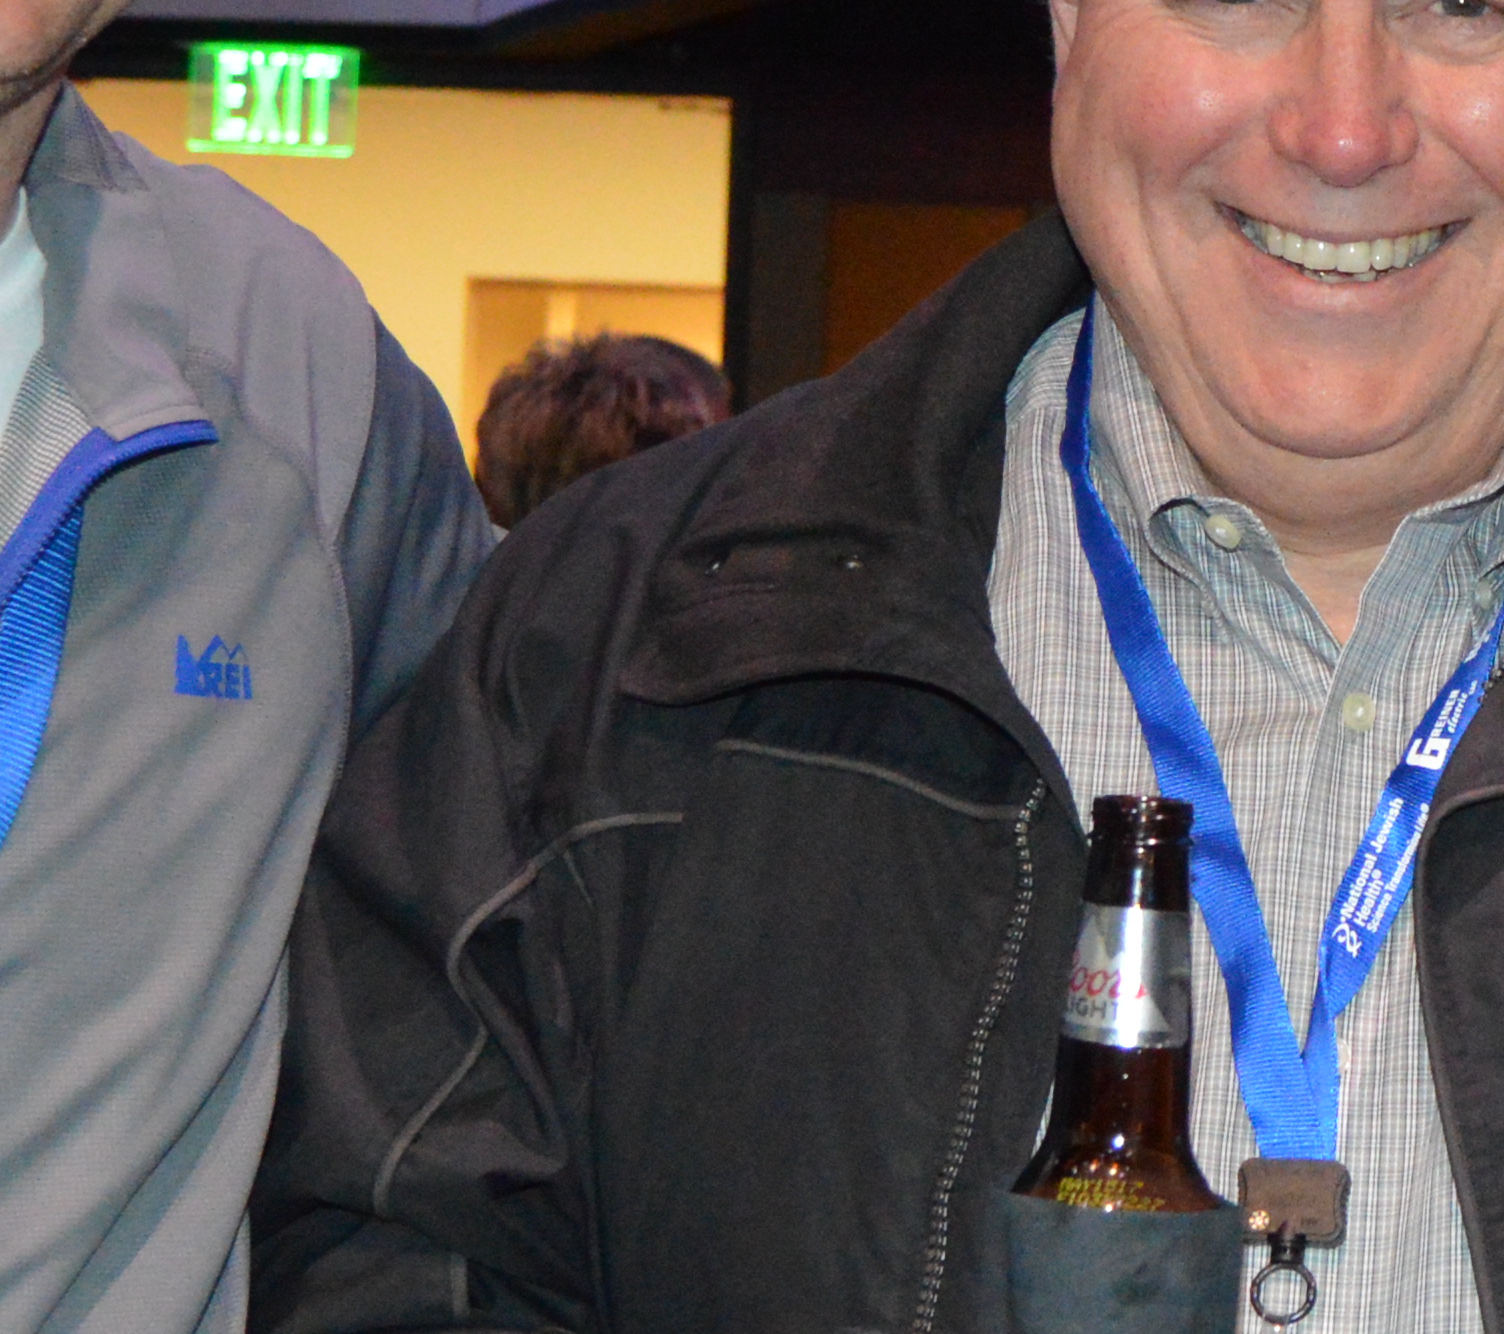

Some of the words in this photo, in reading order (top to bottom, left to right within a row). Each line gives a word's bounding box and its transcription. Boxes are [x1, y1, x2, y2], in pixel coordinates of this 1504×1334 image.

[212, 49, 343, 145] EXIT
[1406, 689, 1461, 770] GREINER
[1447, 691, 1468, 734] electric
[1342, 852, 1377, 918] National
[1370, 797, 1404, 854] Jewish
[1367, 893, 1393, 933] Science
